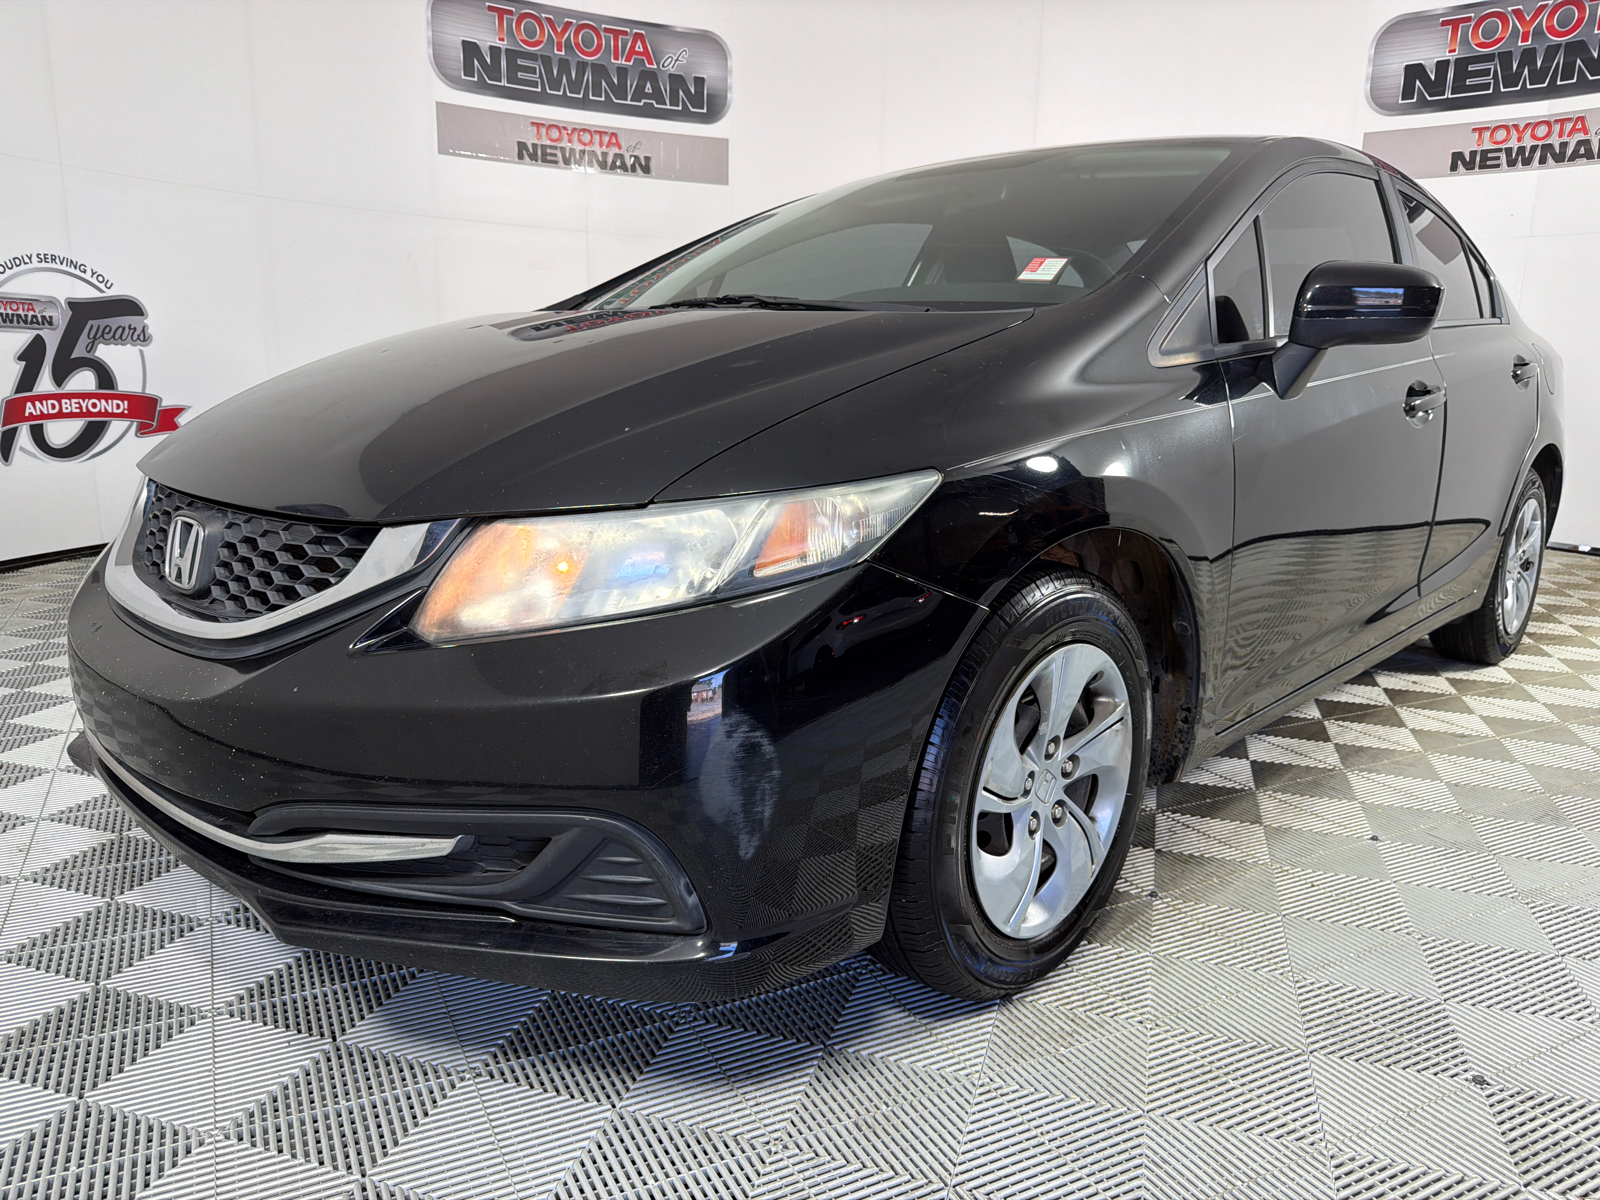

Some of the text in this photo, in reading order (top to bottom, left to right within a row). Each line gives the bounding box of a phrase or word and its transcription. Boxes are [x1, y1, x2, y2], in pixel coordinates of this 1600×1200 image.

[486, 3, 688, 70] TOYOTA of
[460, 38, 707, 113] NEWNAN
[1399, 38, 1600, 104] NEWN
[530, 121, 642, 153] TOYOTA of
[1471, 115, 1591, 147] TOYOTA
[516, 140, 652, 176] NEWNAN
[1449, 138, 1600, 174] NEWNA
[0, 252, 115, 290] OUDLY SERVING YOU
[0, 300, 47, 315] YOTA of
[0, 312, 54, 327] WNAN
[87, 322, 150, 354] years
[25, 398, 129, 416] AND BEYOND!
